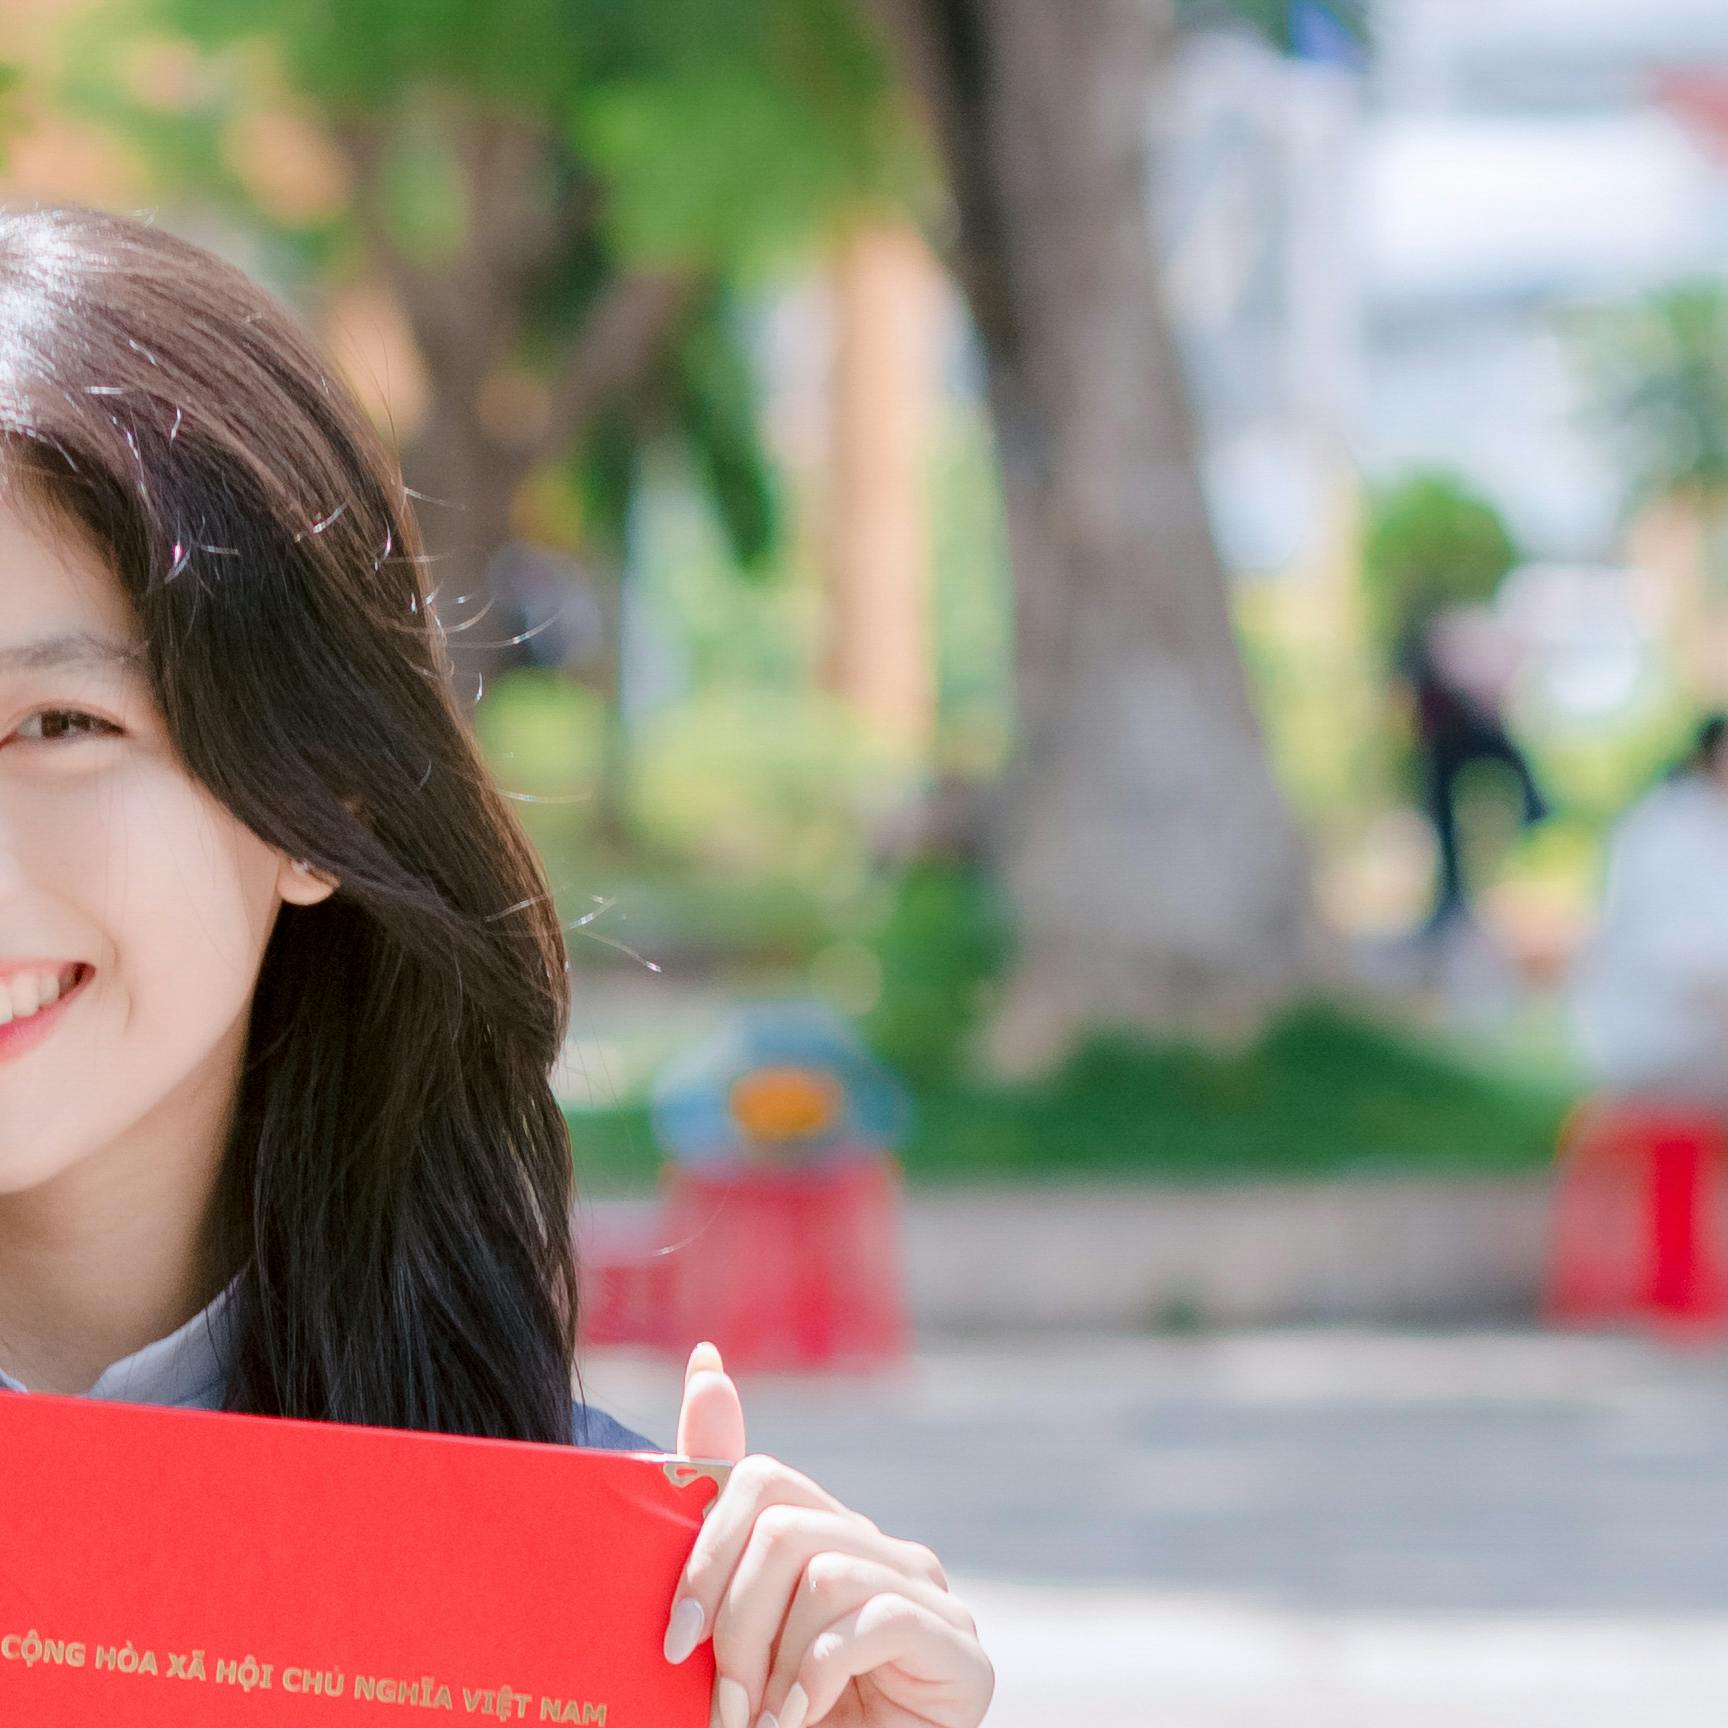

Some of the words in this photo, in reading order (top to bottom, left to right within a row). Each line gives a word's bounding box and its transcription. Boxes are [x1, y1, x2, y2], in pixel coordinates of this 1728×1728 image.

[1, 1629, 86, 1667] CỘNG
[95, 1640, 158, 1675] HÒA
[166, 1650, 206, 1681] XÃ
[216, 1654, 273, 1692] HỘI
[282, 1664, 344, 1697] CHỦ
[354, 1675, 453, 1710] NGHĨA
[462, 1684, 532, 1722] VIỆT
[540, 1696, 608, 1728] NAM
